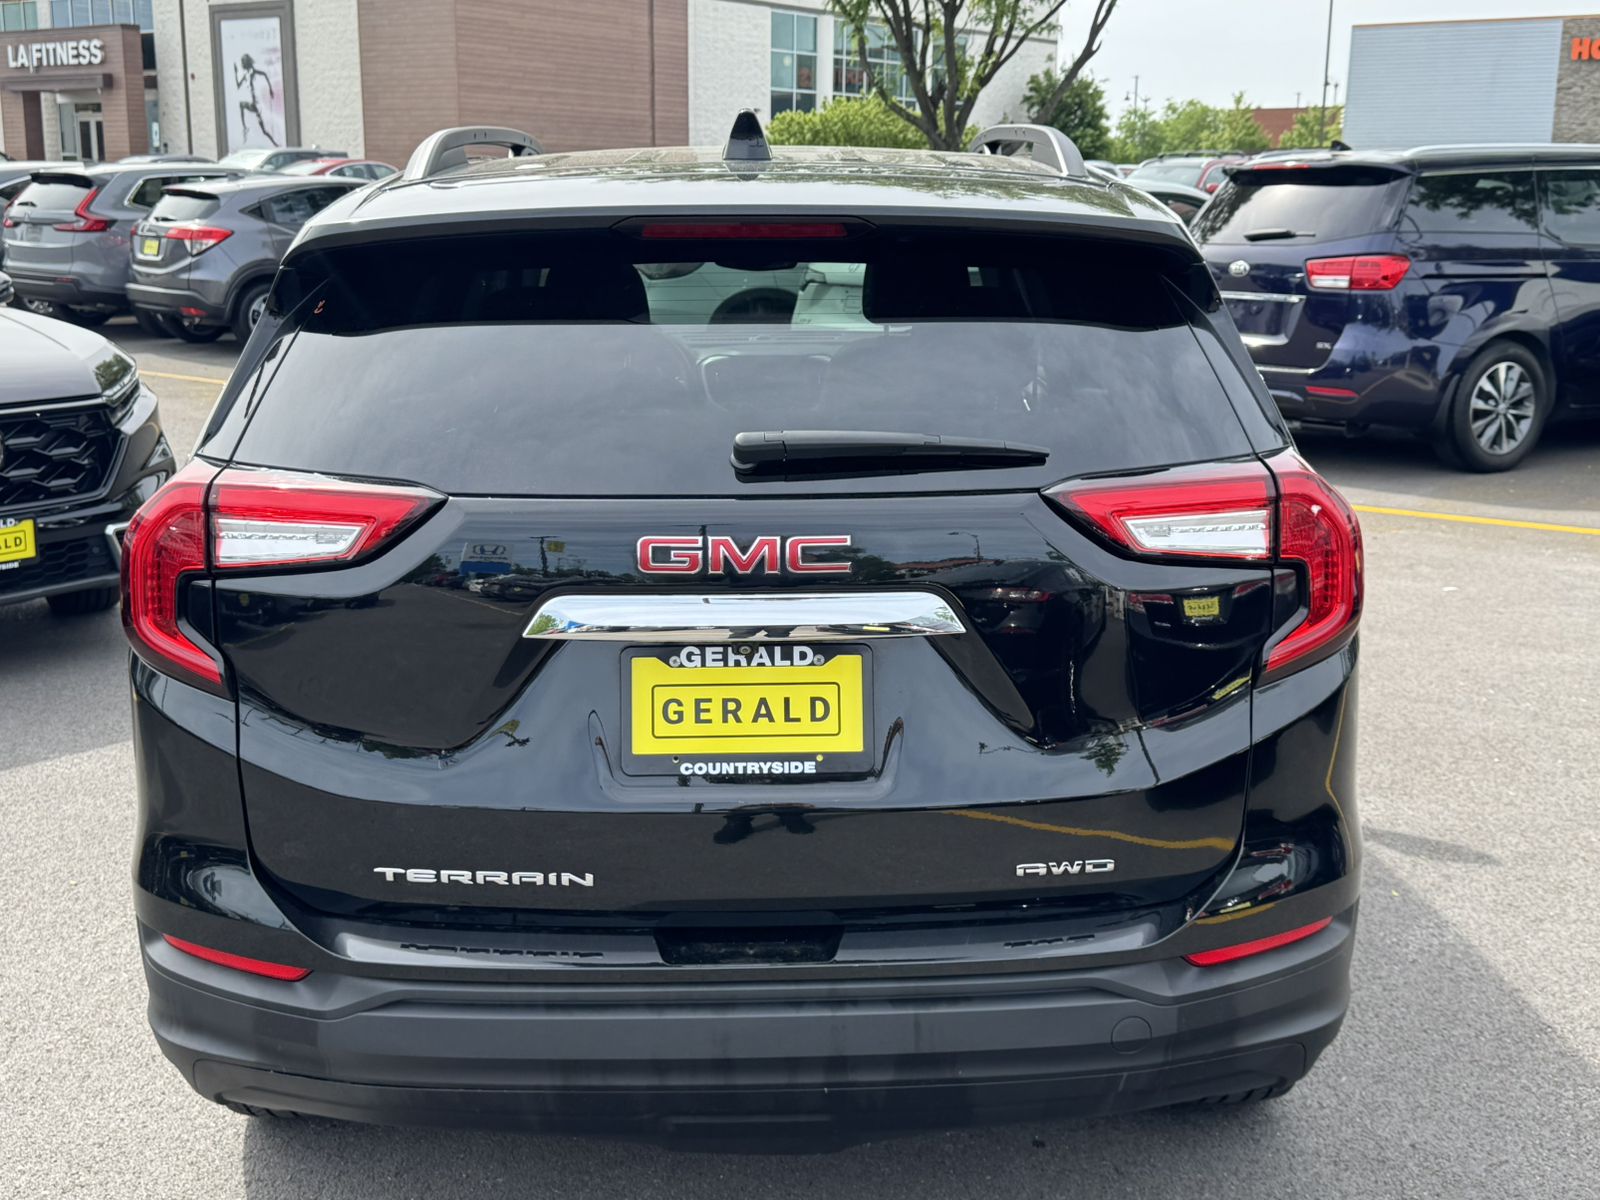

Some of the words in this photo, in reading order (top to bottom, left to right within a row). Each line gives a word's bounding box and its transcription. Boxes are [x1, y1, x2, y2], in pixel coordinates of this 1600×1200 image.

[7, 43, 29, 68] LA
[31, 38, 104, 67] FITNESS
[637, 535, 851, 574] GMC
[679, 645, 814, 668] GERALD
[662, 696, 831, 725] GERALD
[679, 761, 817, 775] COUNTRYSIDE
[373, 867, 594, 886] TERRAIN
[1016, 858, 1115, 876] AWD
